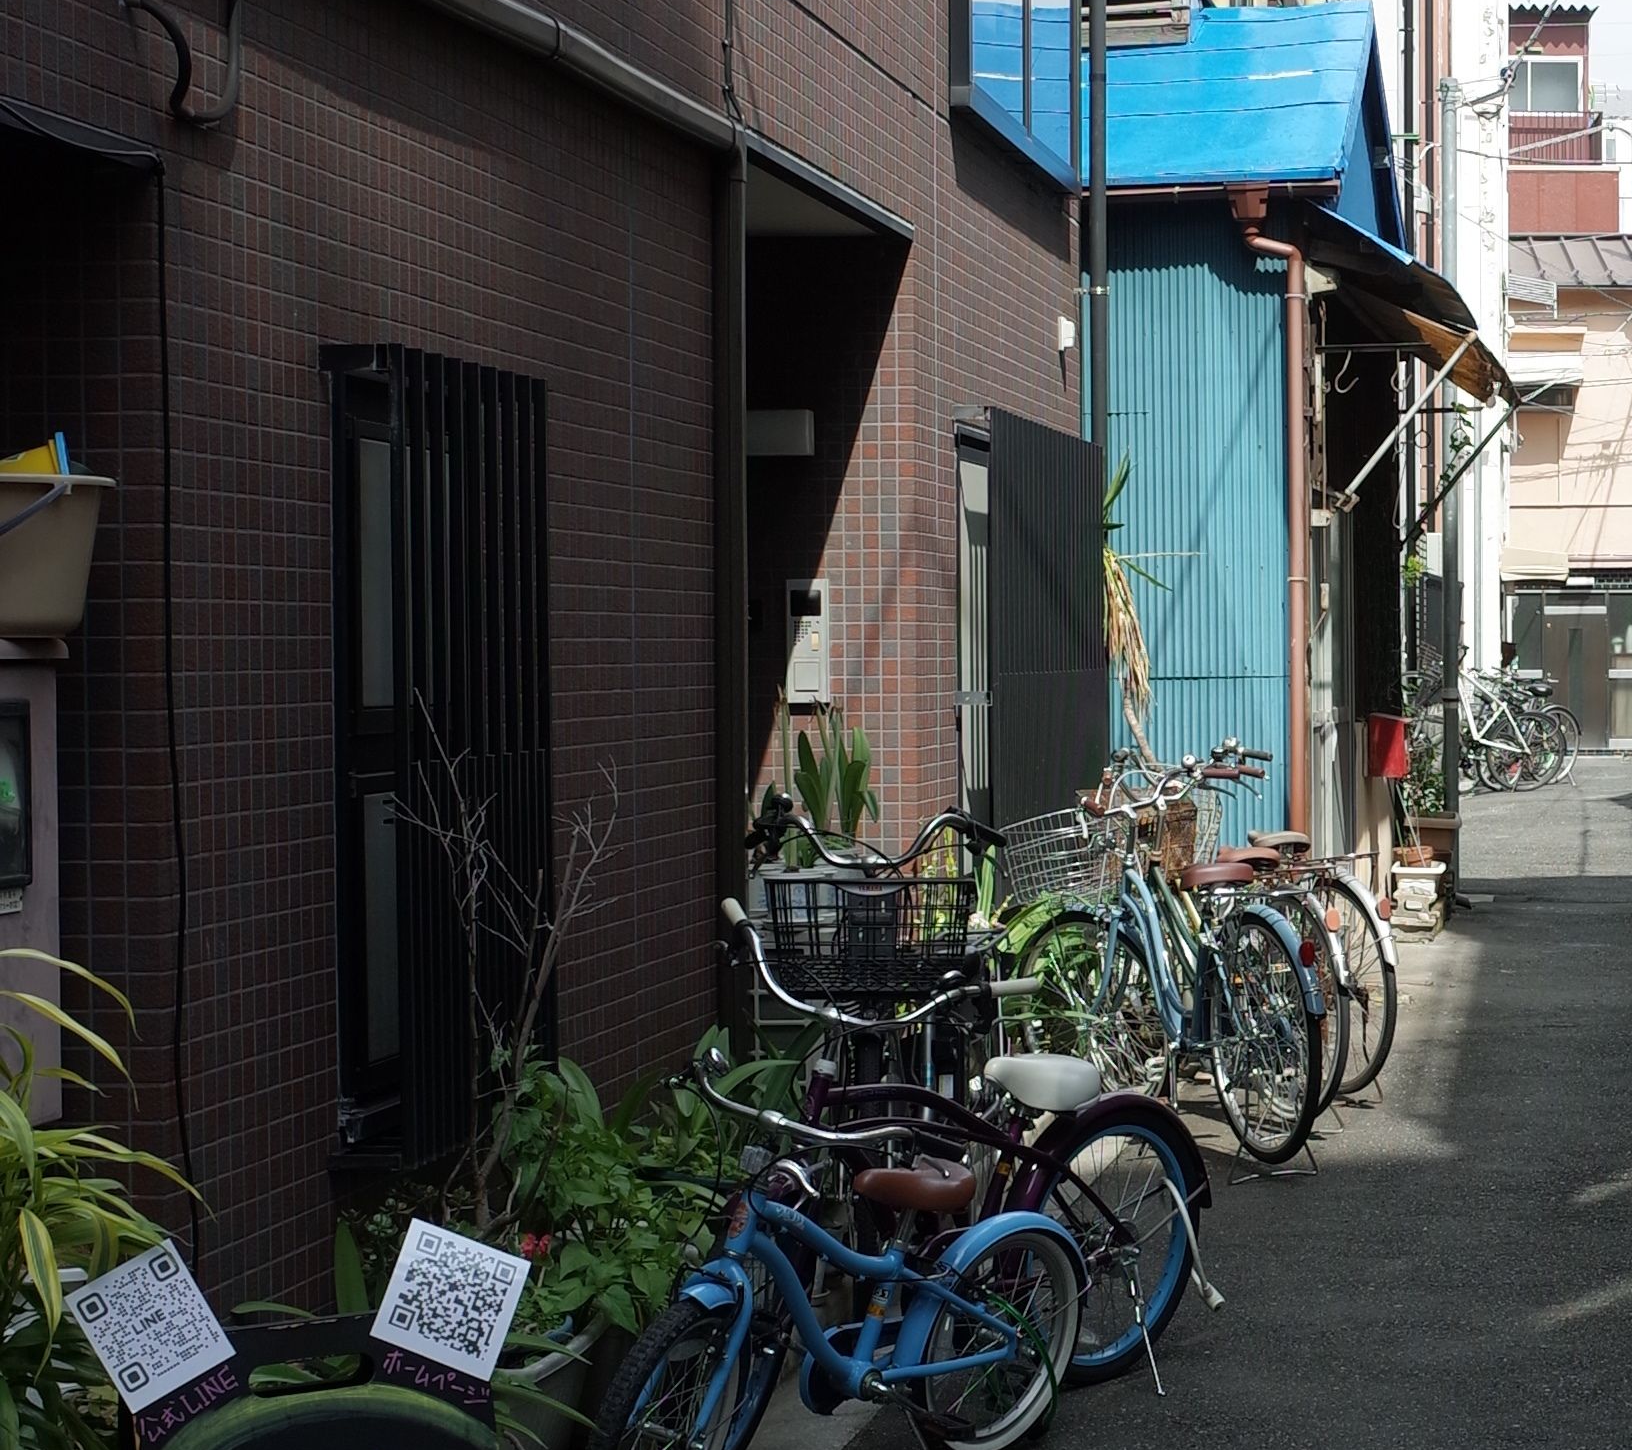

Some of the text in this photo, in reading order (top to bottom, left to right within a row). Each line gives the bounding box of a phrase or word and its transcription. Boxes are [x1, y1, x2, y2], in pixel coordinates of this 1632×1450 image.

[131, 1308, 167, 1336] LINE
[140, 1364, 239, 1443] 公式LINE
[382, 1350, 491, 1404] ホームページ
